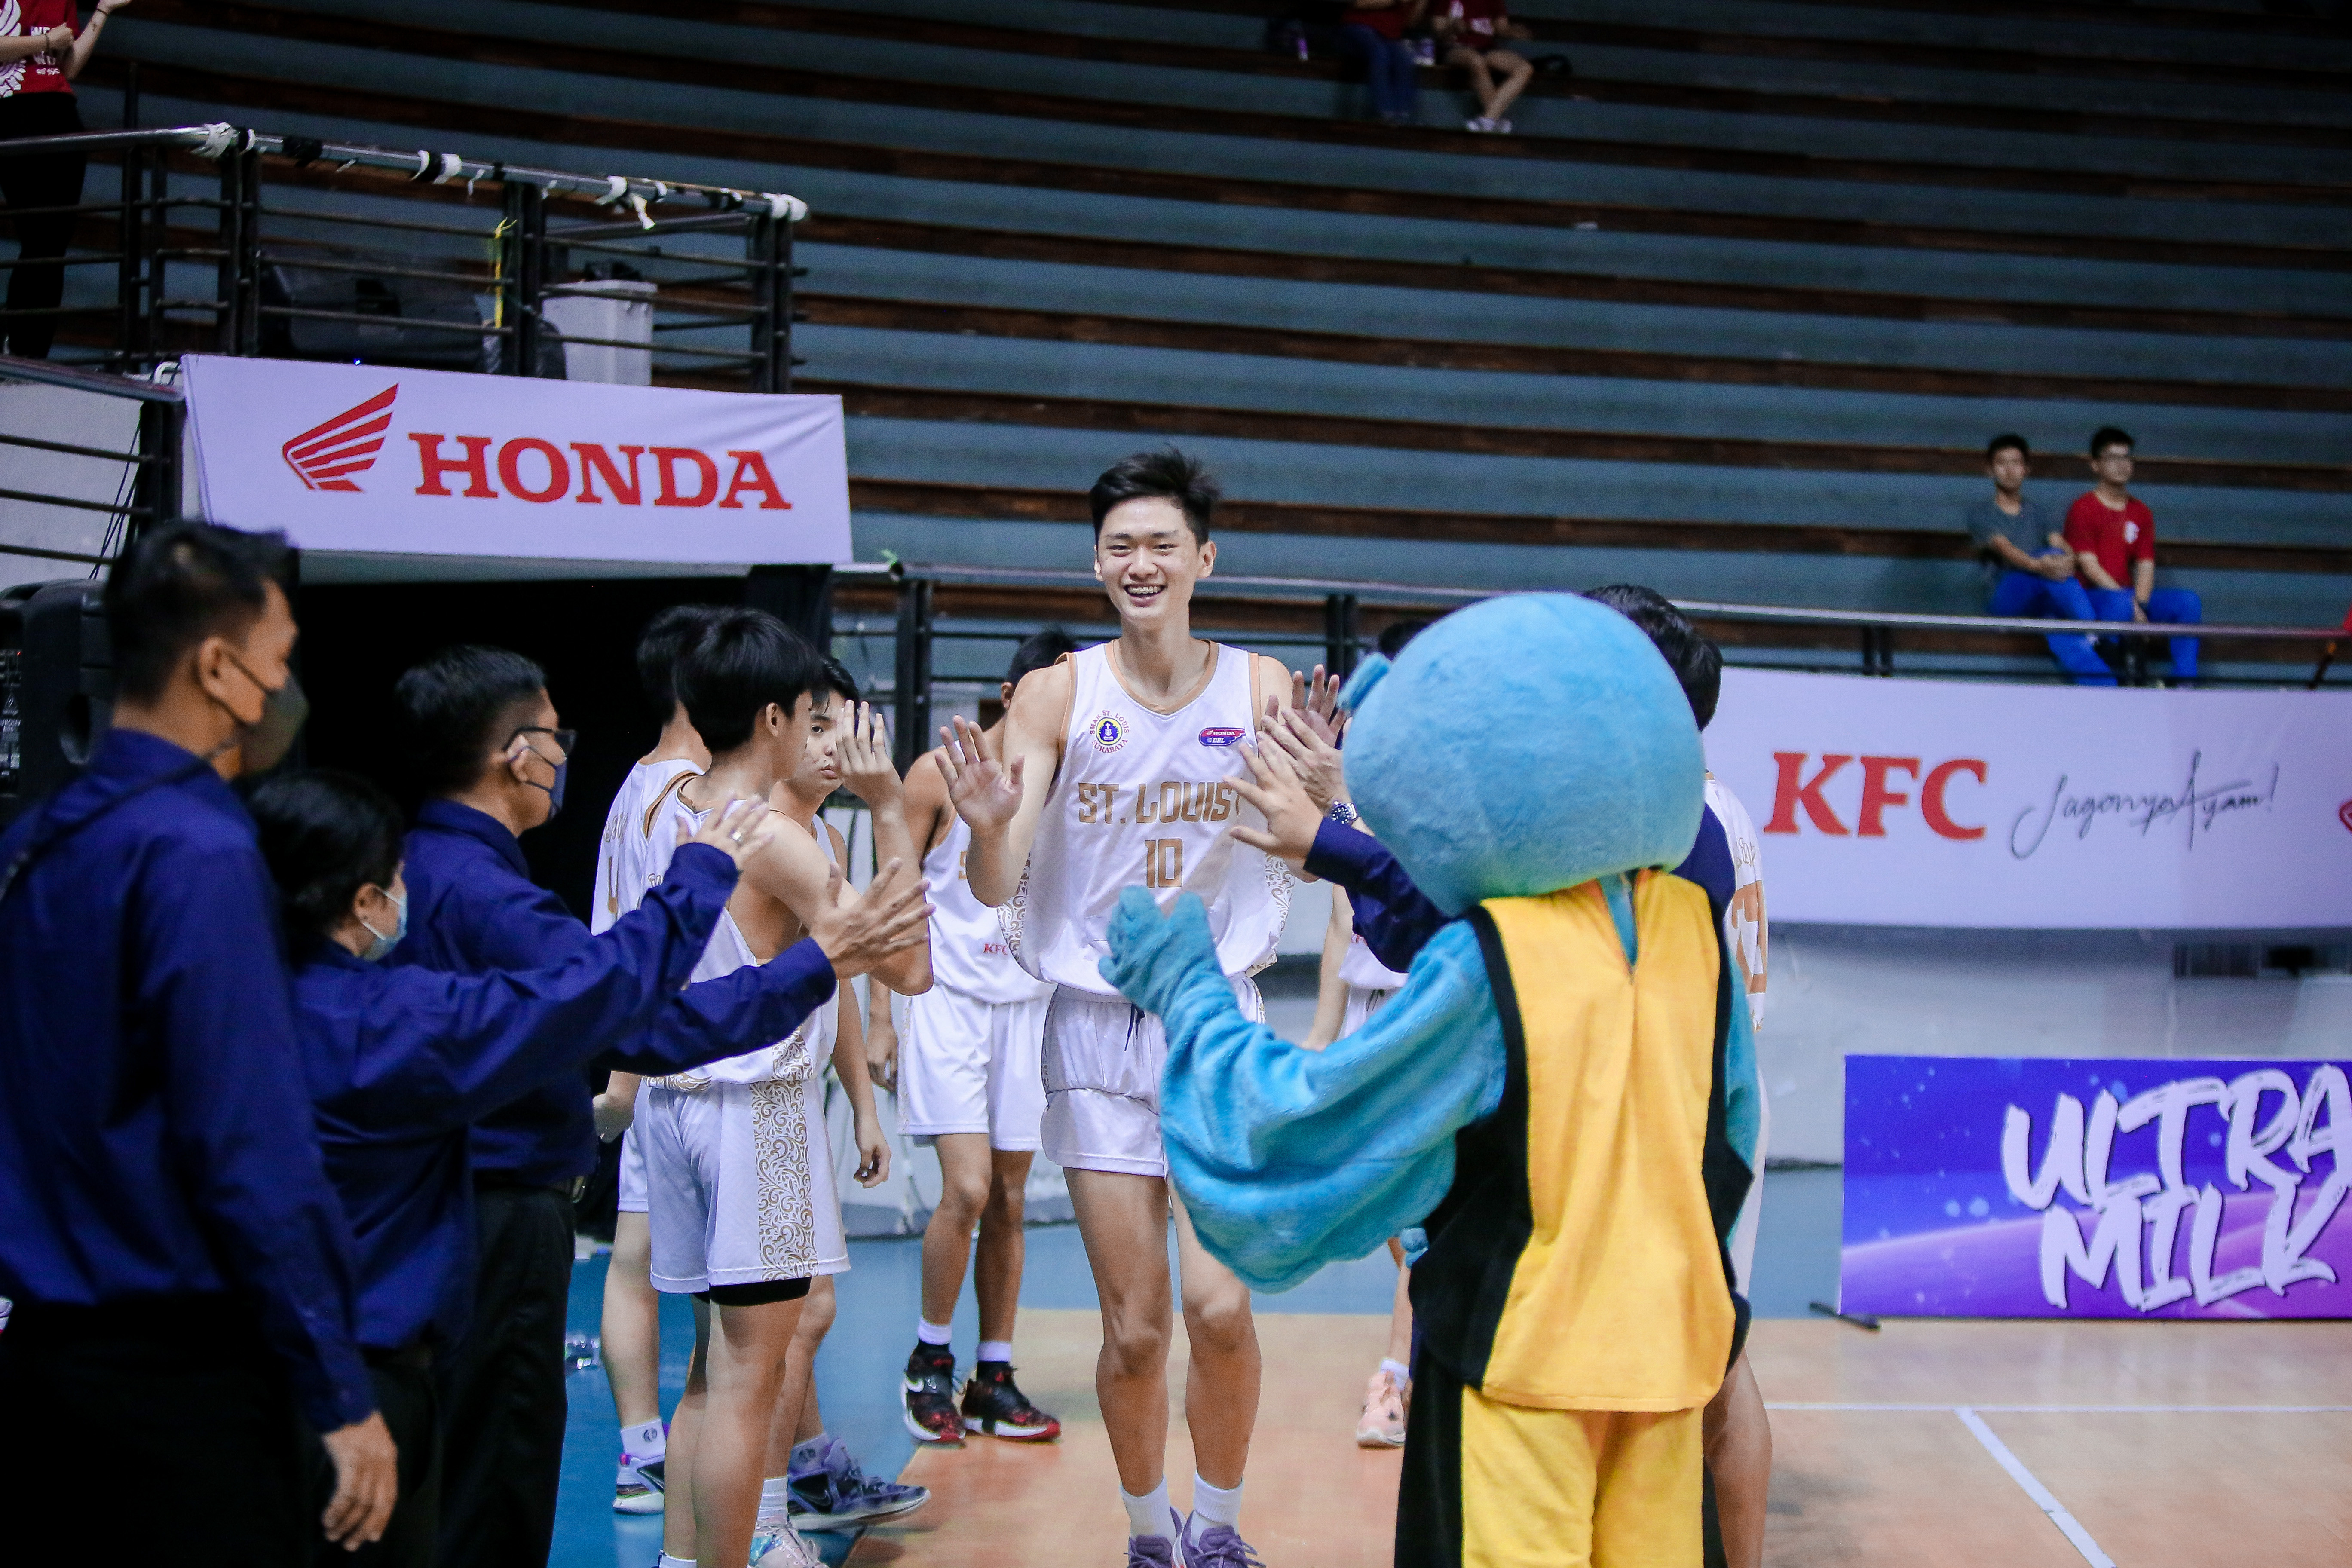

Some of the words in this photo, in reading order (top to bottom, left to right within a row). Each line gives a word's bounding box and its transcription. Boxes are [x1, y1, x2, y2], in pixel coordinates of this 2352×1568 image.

[408, 432, 792, 510] HONDA
[1090, 714, 1101, 735] SMAK
[1114, 713, 1130, 733] LOUIS
[1092, 739, 1129, 753] SURABAYA
[1078, 782, 1126, 824] ST.
[1136, 781, 1233, 824] LOUIS
[1764, 751, 1988, 841] KFC
[1145, 838, 1183, 888] 10
[2001, 1063, 2352, 1212] ULTRA
[2040, 1182, 2352, 1312] MILK
